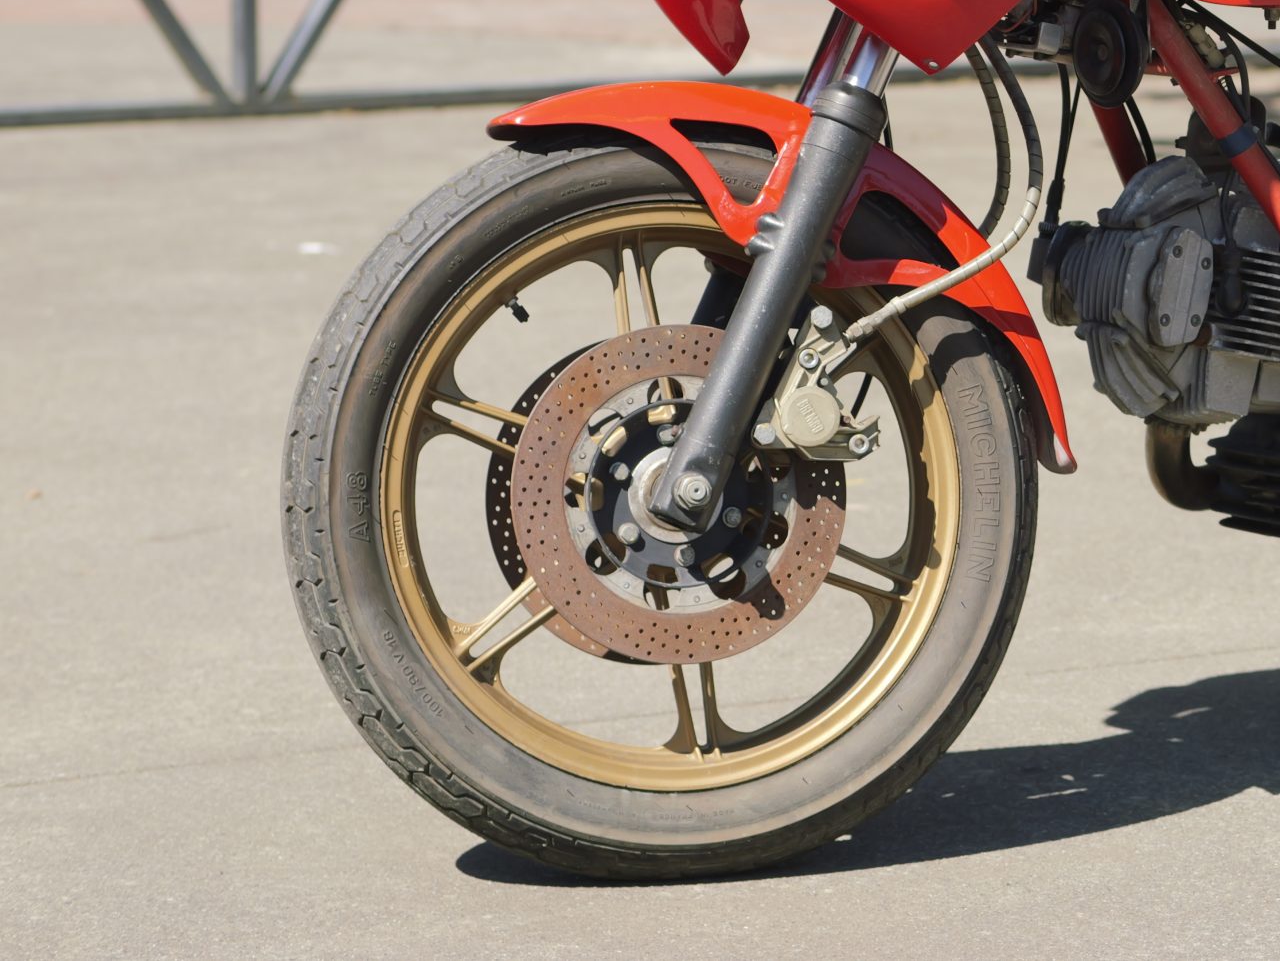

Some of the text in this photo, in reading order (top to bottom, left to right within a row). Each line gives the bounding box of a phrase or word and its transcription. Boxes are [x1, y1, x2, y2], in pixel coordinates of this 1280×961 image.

[957, 383, 1000, 583] MICHELIN
[383, 630, 444, 718] 100/90 V 18
